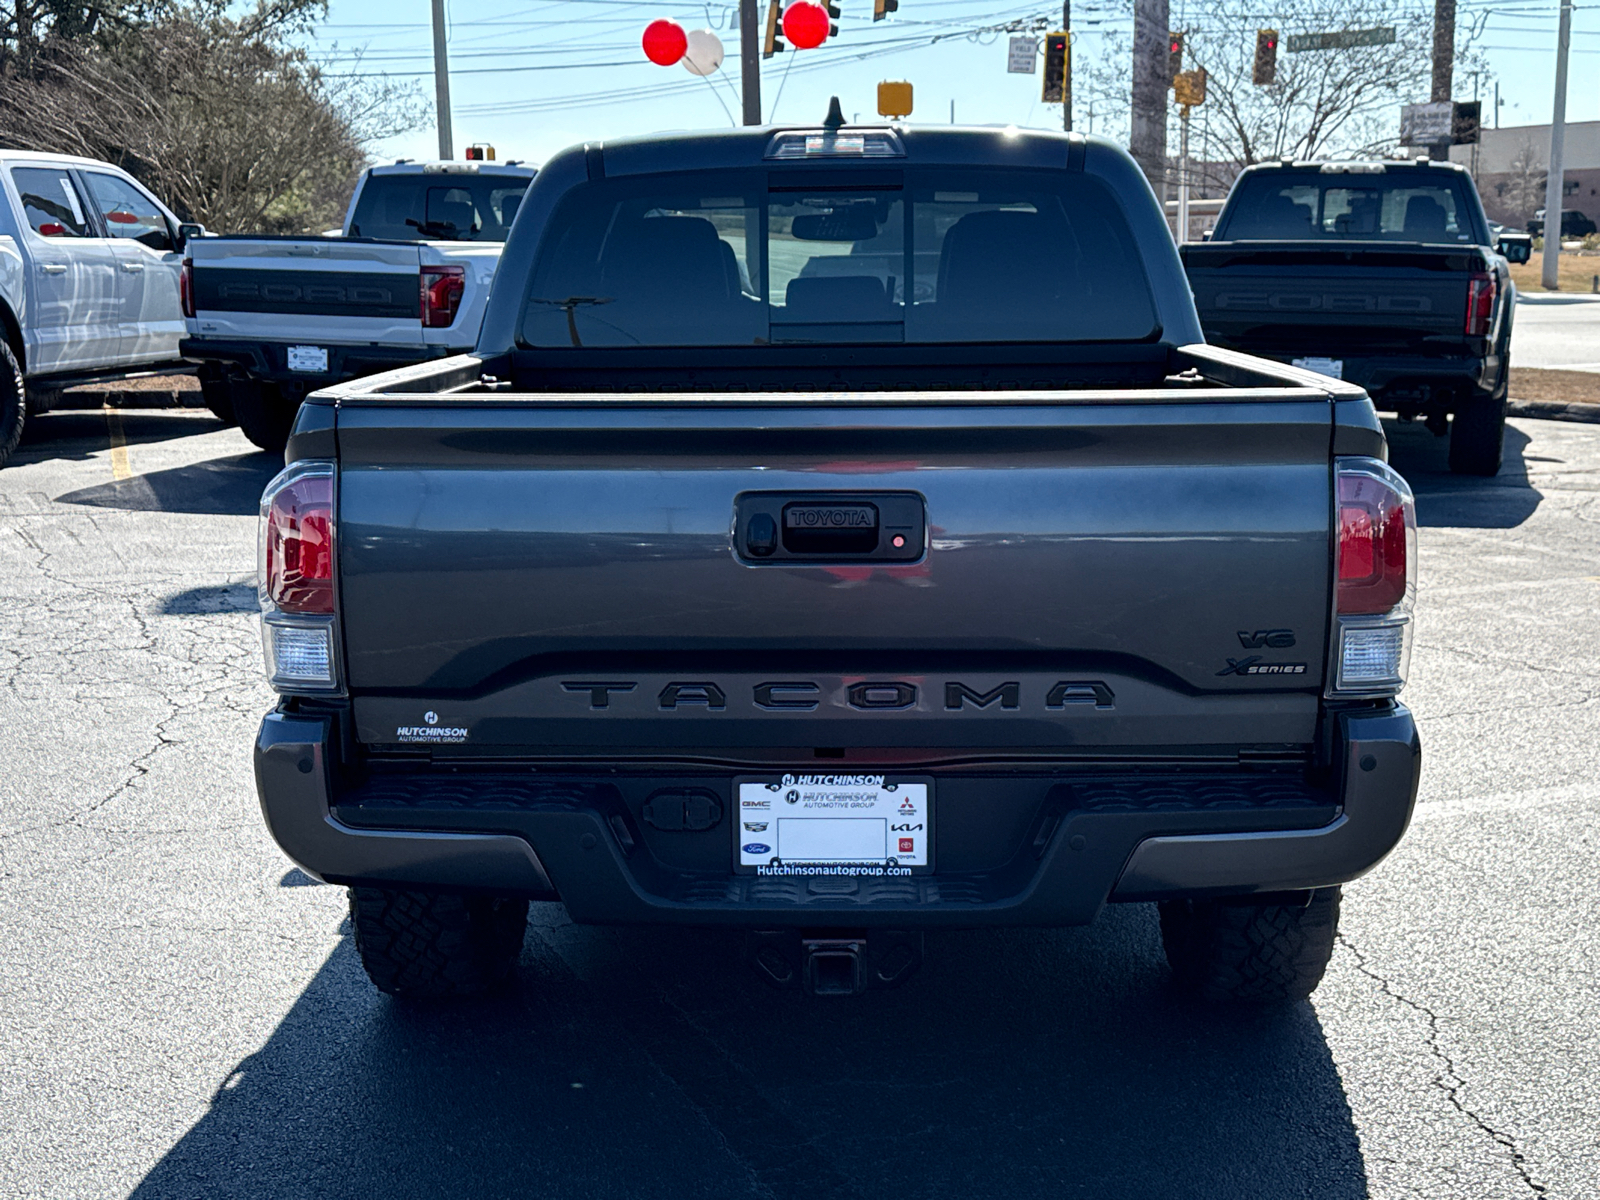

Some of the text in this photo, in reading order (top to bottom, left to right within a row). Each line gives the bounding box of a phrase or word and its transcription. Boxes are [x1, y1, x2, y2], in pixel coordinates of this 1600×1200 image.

[218, 283, 393, 304] FORD
[1215, 292, 1432, 312] FORD
[791, 509, 872, 526] TOYOTA
[1237, 629, 1296, 649] V6
[560, 681, 1117, 711] TACOMA
[397, 727, 468, 736] HUTCHINSON
[797, 775, 885, 787] HUTCHINSON
[802, 792, 879, 802] HUTCHINSON
[747, 844, 766, 853] Ford
[757, 865, 912, 876] Hutchinsonautogroup.com
